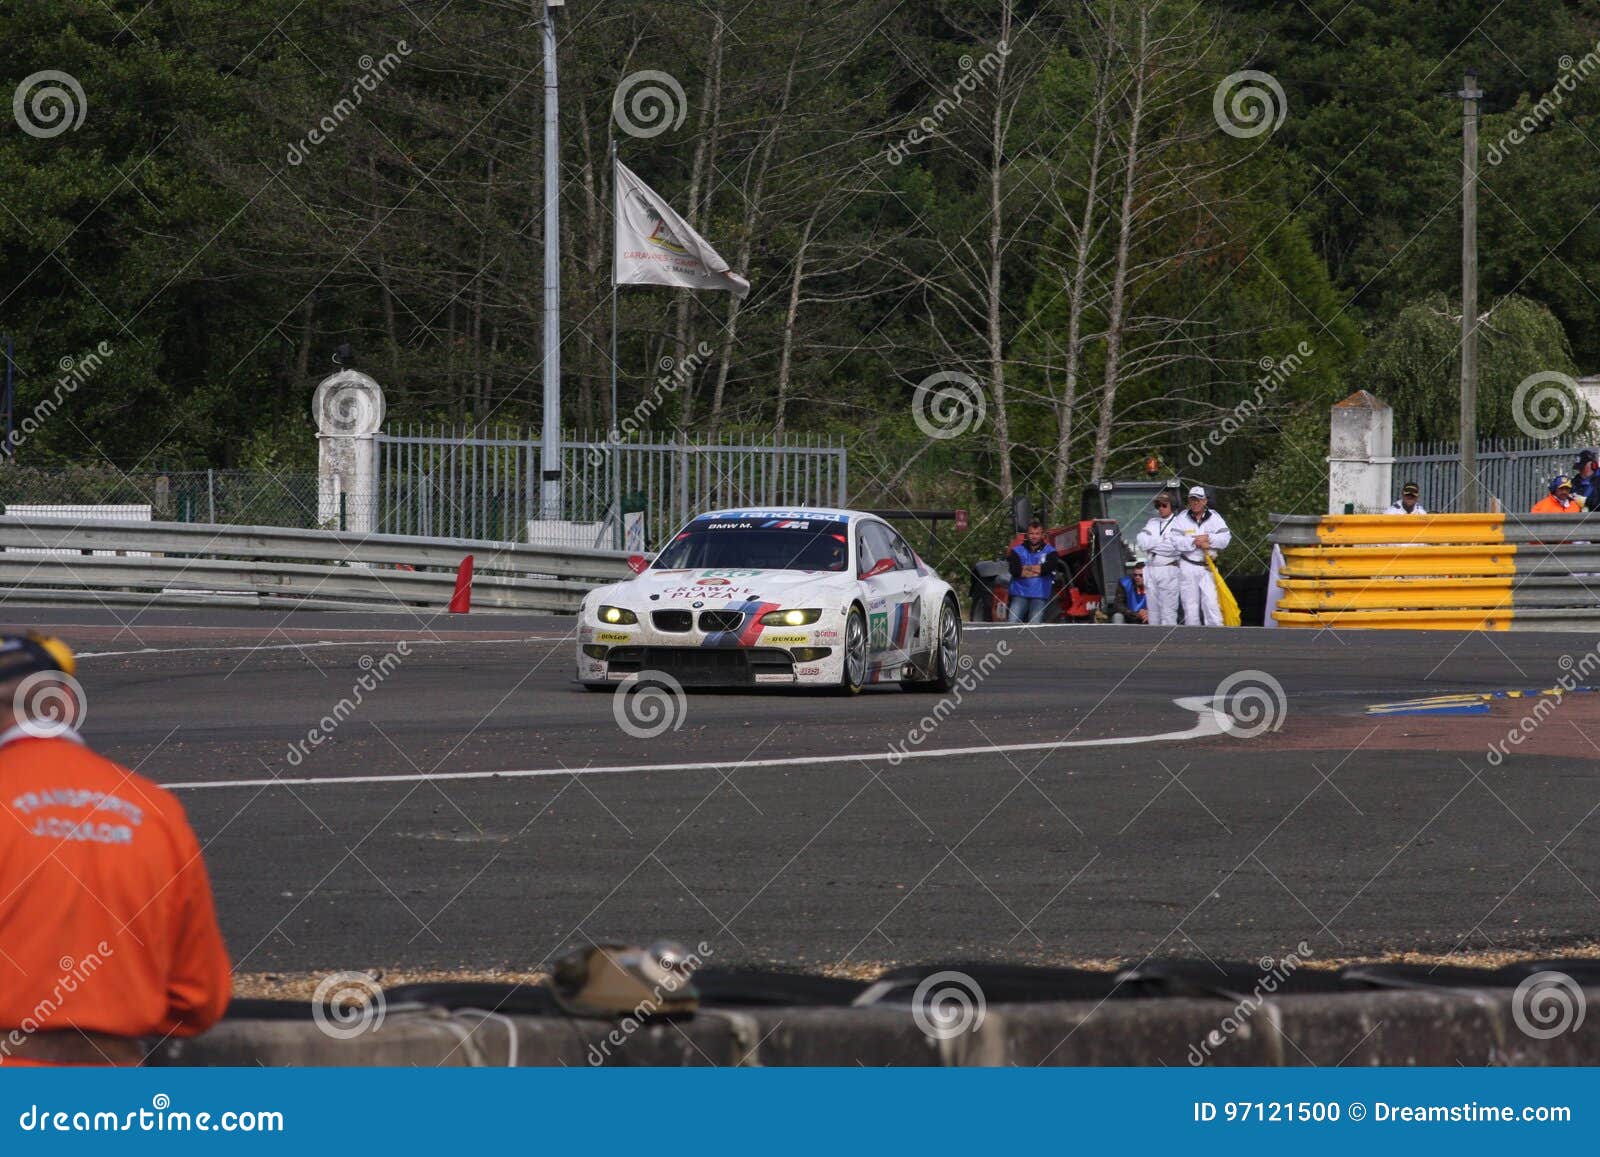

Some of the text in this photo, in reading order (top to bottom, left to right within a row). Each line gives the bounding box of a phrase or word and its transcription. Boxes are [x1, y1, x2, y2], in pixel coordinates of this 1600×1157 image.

[740, 511, 841, 522] randstad
[663, 586, 755, 594] CROWNE
[671, 591, 733, 600] PLAZA
[601, 633, 629, 641] DUNLOP
[13, 788, 143, 826] TRANSPORTS
